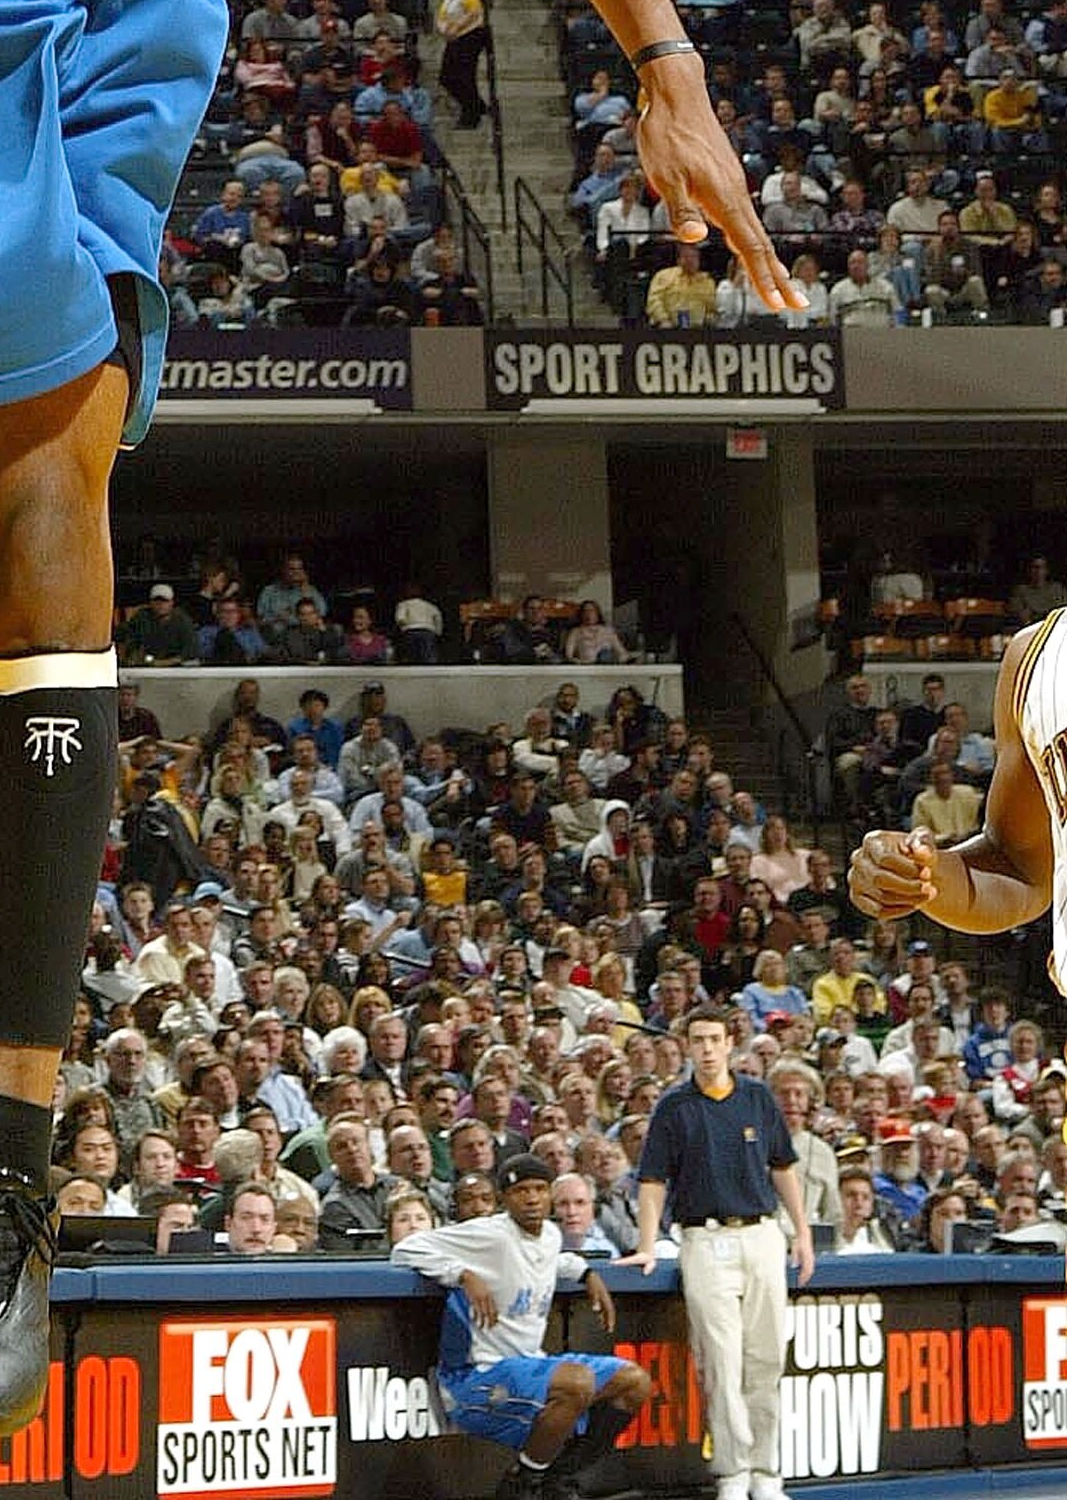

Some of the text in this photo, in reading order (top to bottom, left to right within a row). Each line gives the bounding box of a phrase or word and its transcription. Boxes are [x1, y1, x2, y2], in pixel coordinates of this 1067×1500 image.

[494, 342, 836, 395] SPORT GRAPHICS
[192, 1327, 312, 1422] FOX
[887, 1327, 1013, 1431] PERIOD
[163, 1425, 331, 1485] SPORTS NET
[780, 1372, 883, 1479] HOW
